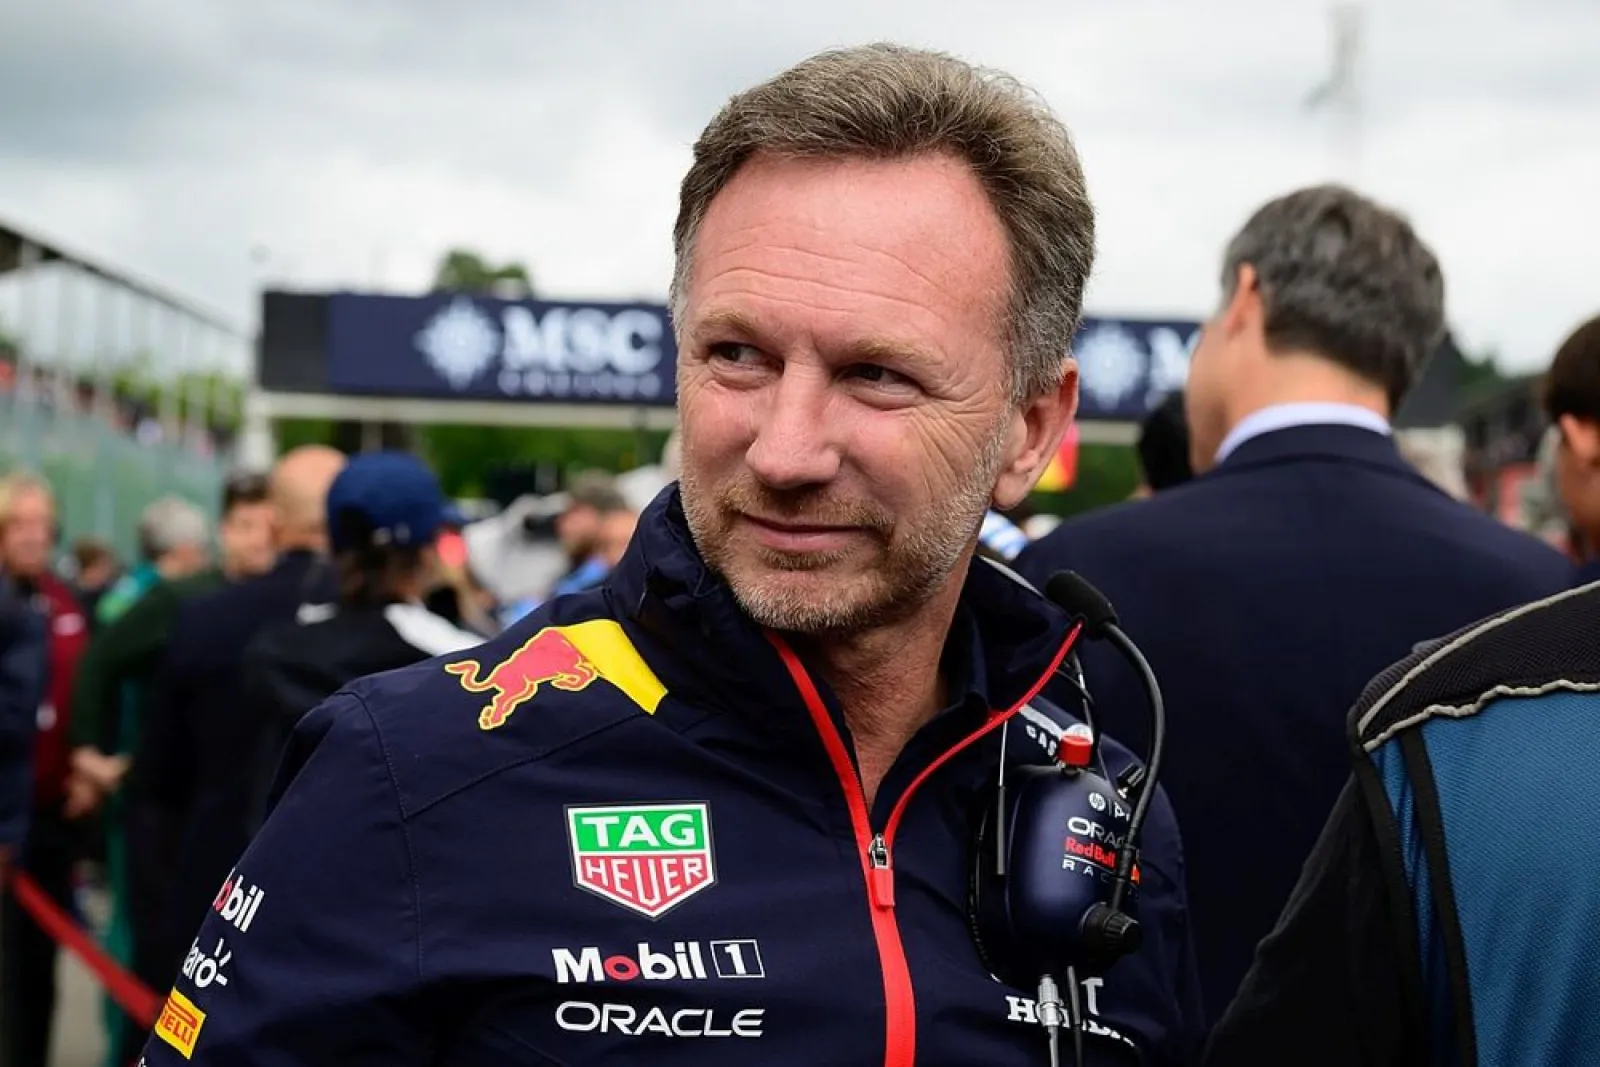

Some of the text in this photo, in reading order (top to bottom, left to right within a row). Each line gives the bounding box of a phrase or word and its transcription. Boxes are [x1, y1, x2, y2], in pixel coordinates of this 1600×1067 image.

[503, 305, 663, 375] MSC
[581, 813, 696, 848] TAG
[212, 867, 264, 933] obil
[585, 857, 702, 906] HEUER
[551, 941, 708, 983] Mobil
[555, 1001, 765, 1037] ORACLE
